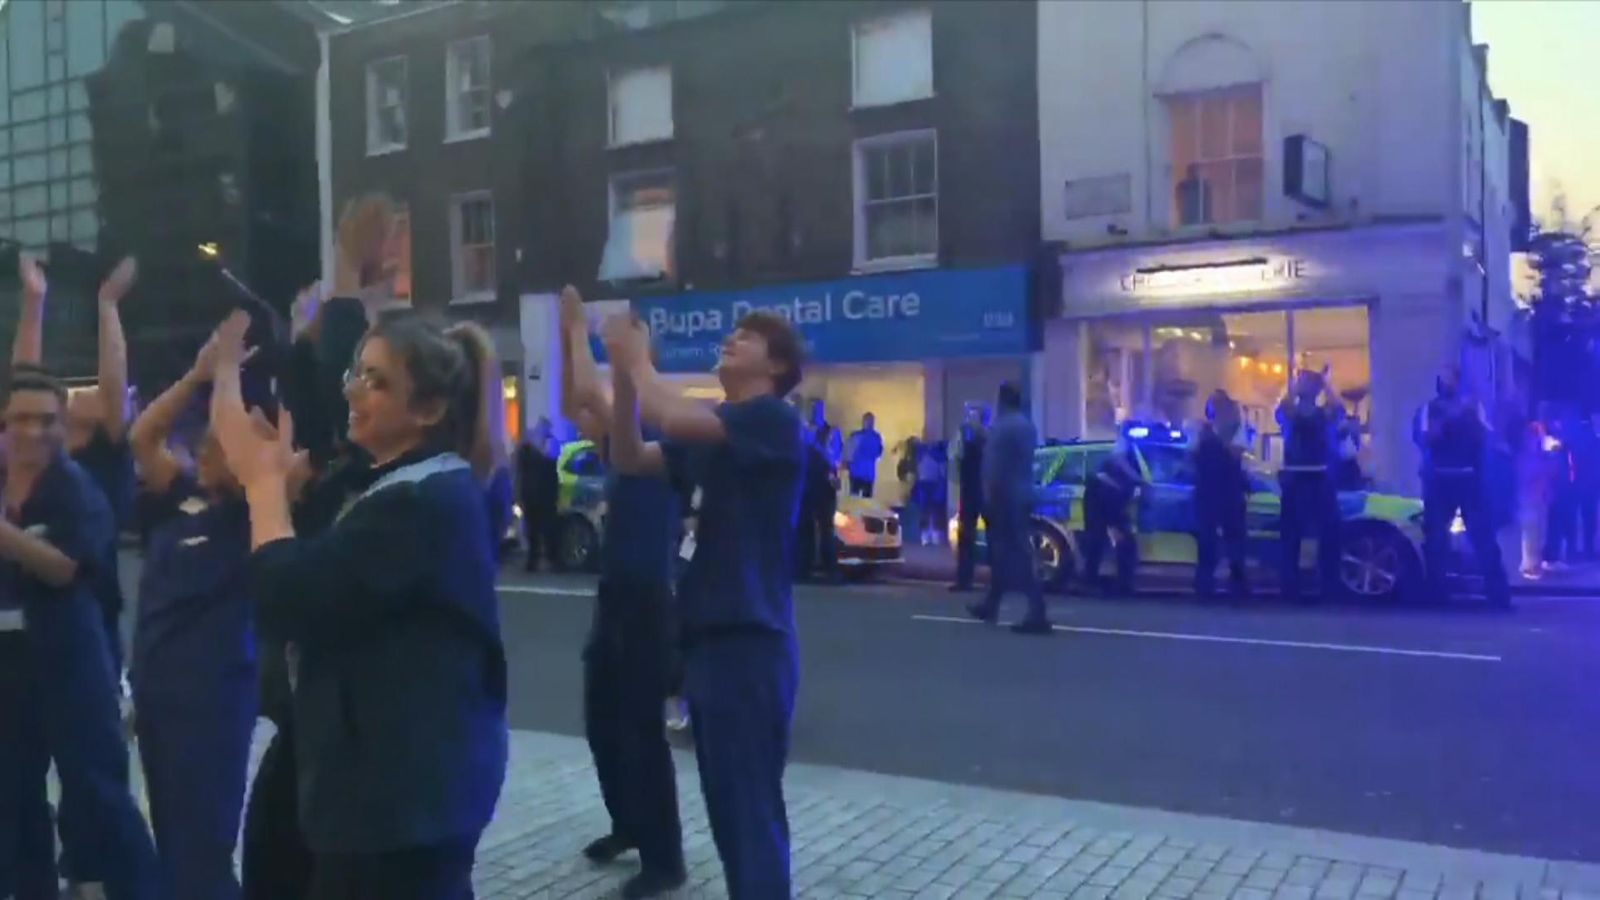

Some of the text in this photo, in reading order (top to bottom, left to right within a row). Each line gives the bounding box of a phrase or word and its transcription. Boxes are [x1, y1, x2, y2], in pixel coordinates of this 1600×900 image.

[649, 290, 920, 338] Bupa Dntal Care
